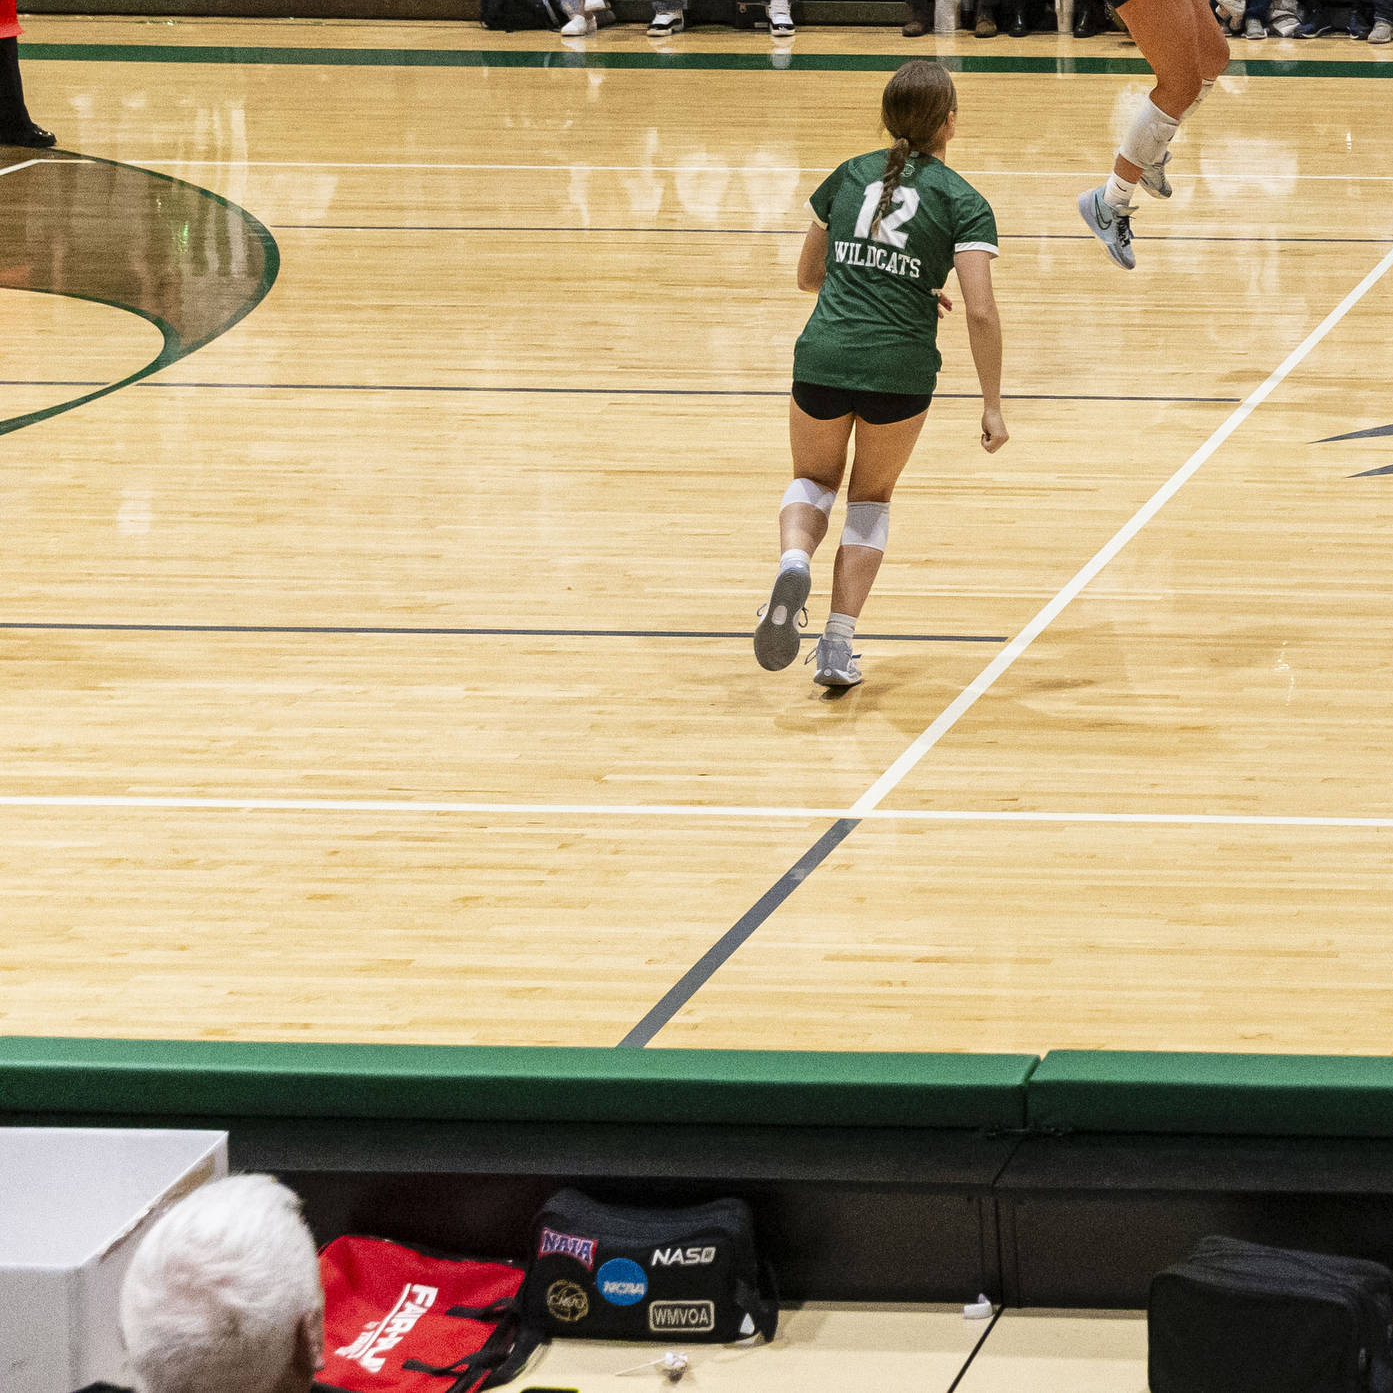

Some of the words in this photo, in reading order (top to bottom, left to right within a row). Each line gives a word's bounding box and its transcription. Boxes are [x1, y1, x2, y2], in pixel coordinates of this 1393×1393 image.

[853, 179, 920, 249] 12
[834, 240, 921, 278] WILDCATS
[542, 1229, 594, 1263] NAIA
[603, 1280, 645, 1295] NCAA
[654, 1309, 709, 1328] WMVOA
